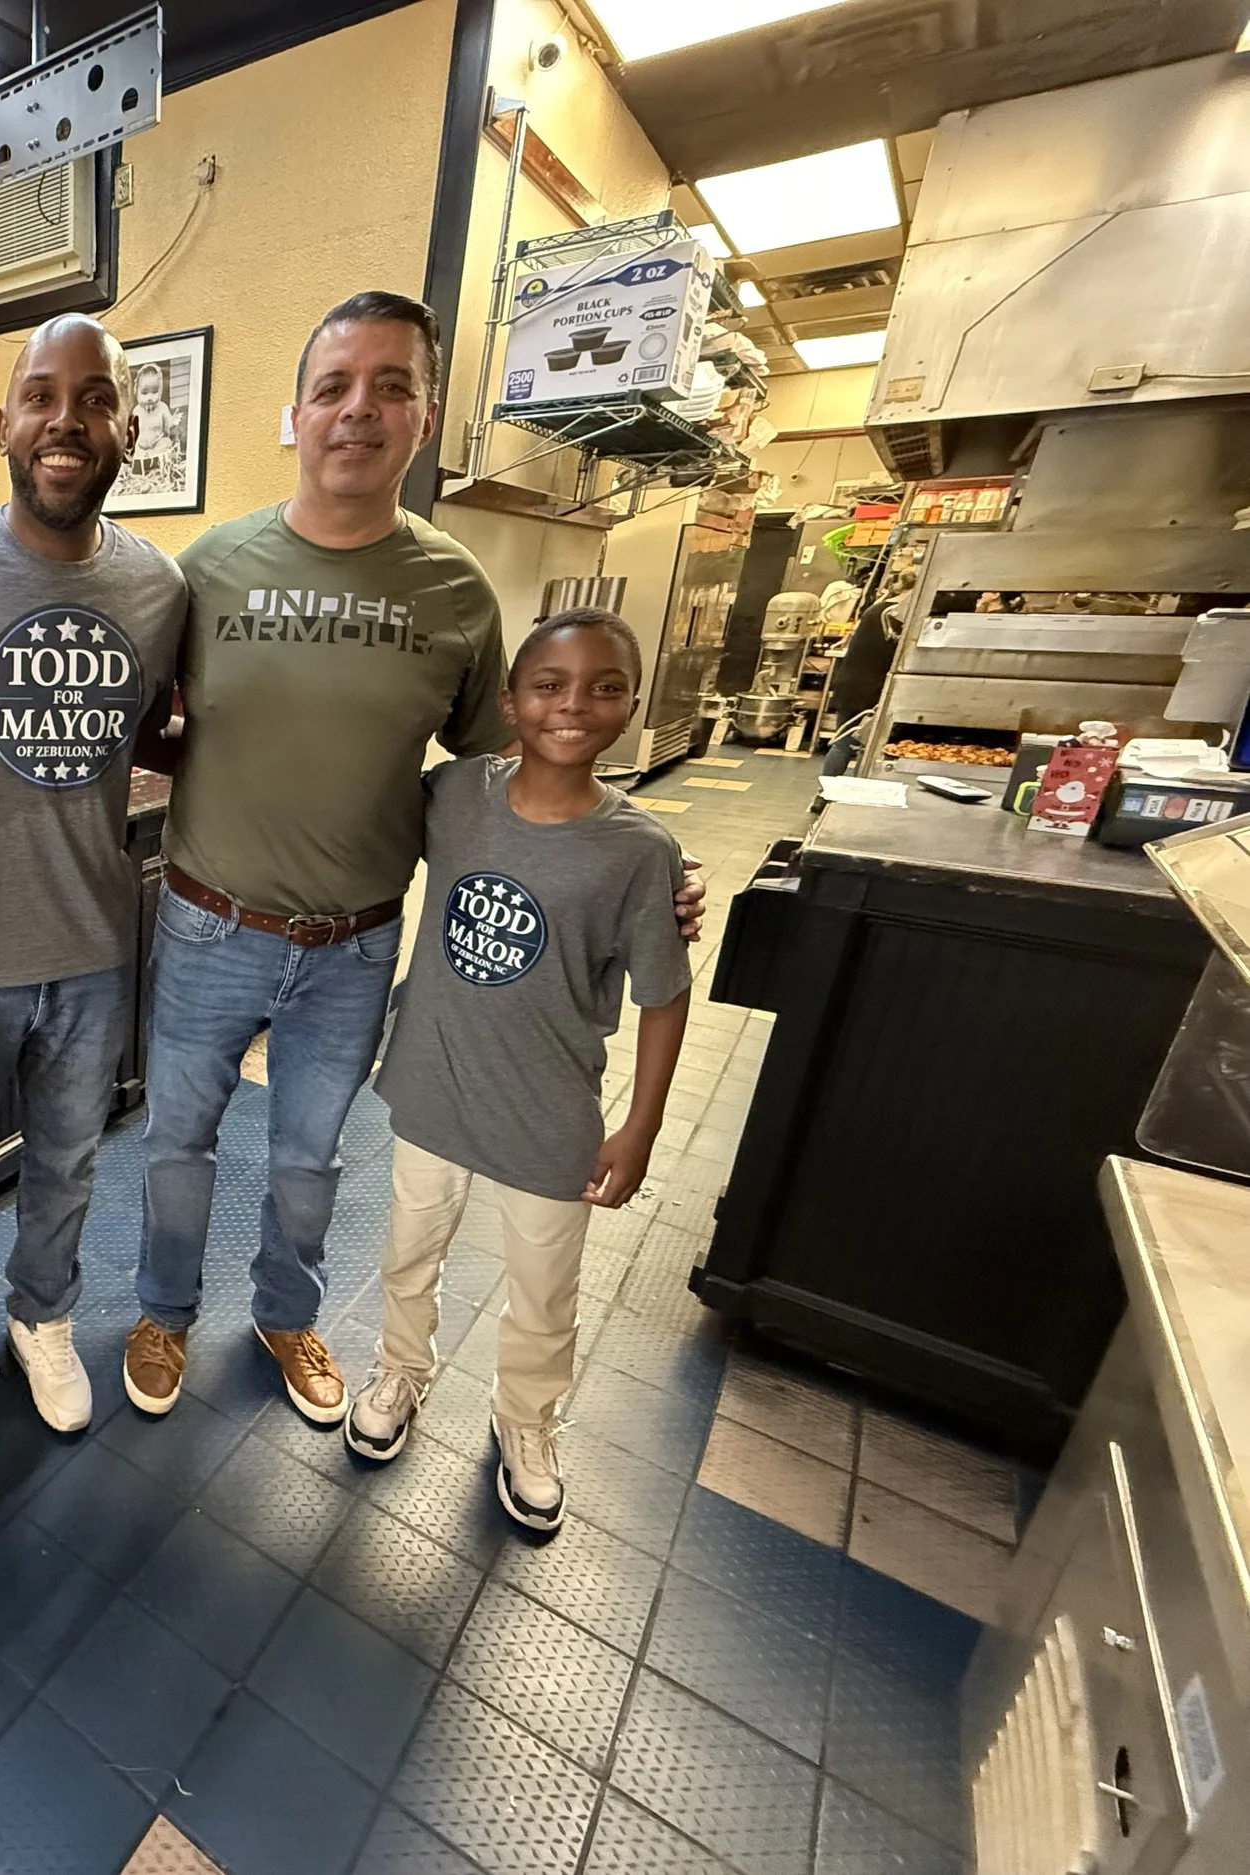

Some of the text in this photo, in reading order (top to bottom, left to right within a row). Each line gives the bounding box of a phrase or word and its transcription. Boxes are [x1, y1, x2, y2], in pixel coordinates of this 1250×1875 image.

[631, 266, 643, 282] 2
[577, 297, 611, 311] BLACK
[553, 310, 602, 328] PORTION
[604, 305, 634, 319] CUPS
[509, 371, 533, 385] 2500
[2, 646, 130, 688] TODD
[52, 690, 84, 705] FOR
[0, 708, 125, 741] MAYOR
[16, 745, 34, 759] OF
[35, 745, 94, 760] ZEBULON,
[458, 886, 537, 935] TODD
[475, 921, 497, 937] FOR
[448, 918, 525, 970] MAYOR
[450, 943, 460, 953] OF
[493, 964, 508, 975] NC
